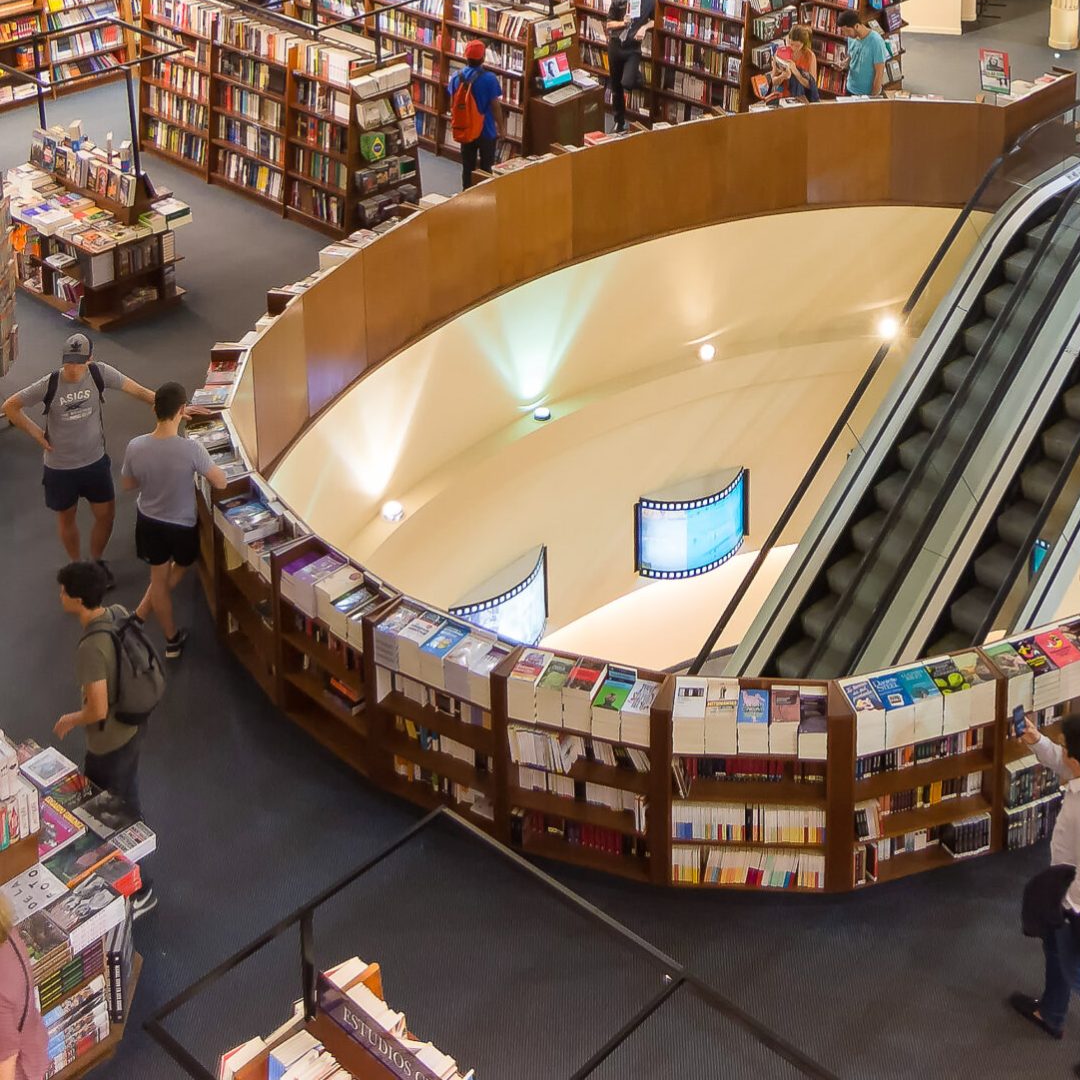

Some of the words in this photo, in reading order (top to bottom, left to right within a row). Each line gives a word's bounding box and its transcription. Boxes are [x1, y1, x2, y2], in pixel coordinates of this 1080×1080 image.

[60, 390, 90, 406] ASICS
[11, 880, 23, 898] LA
[28, 870, 56, 899] FOTO
[23, 896, 38, 910] DE
[342, 1007, 412, 1077] ESTUDIOS
